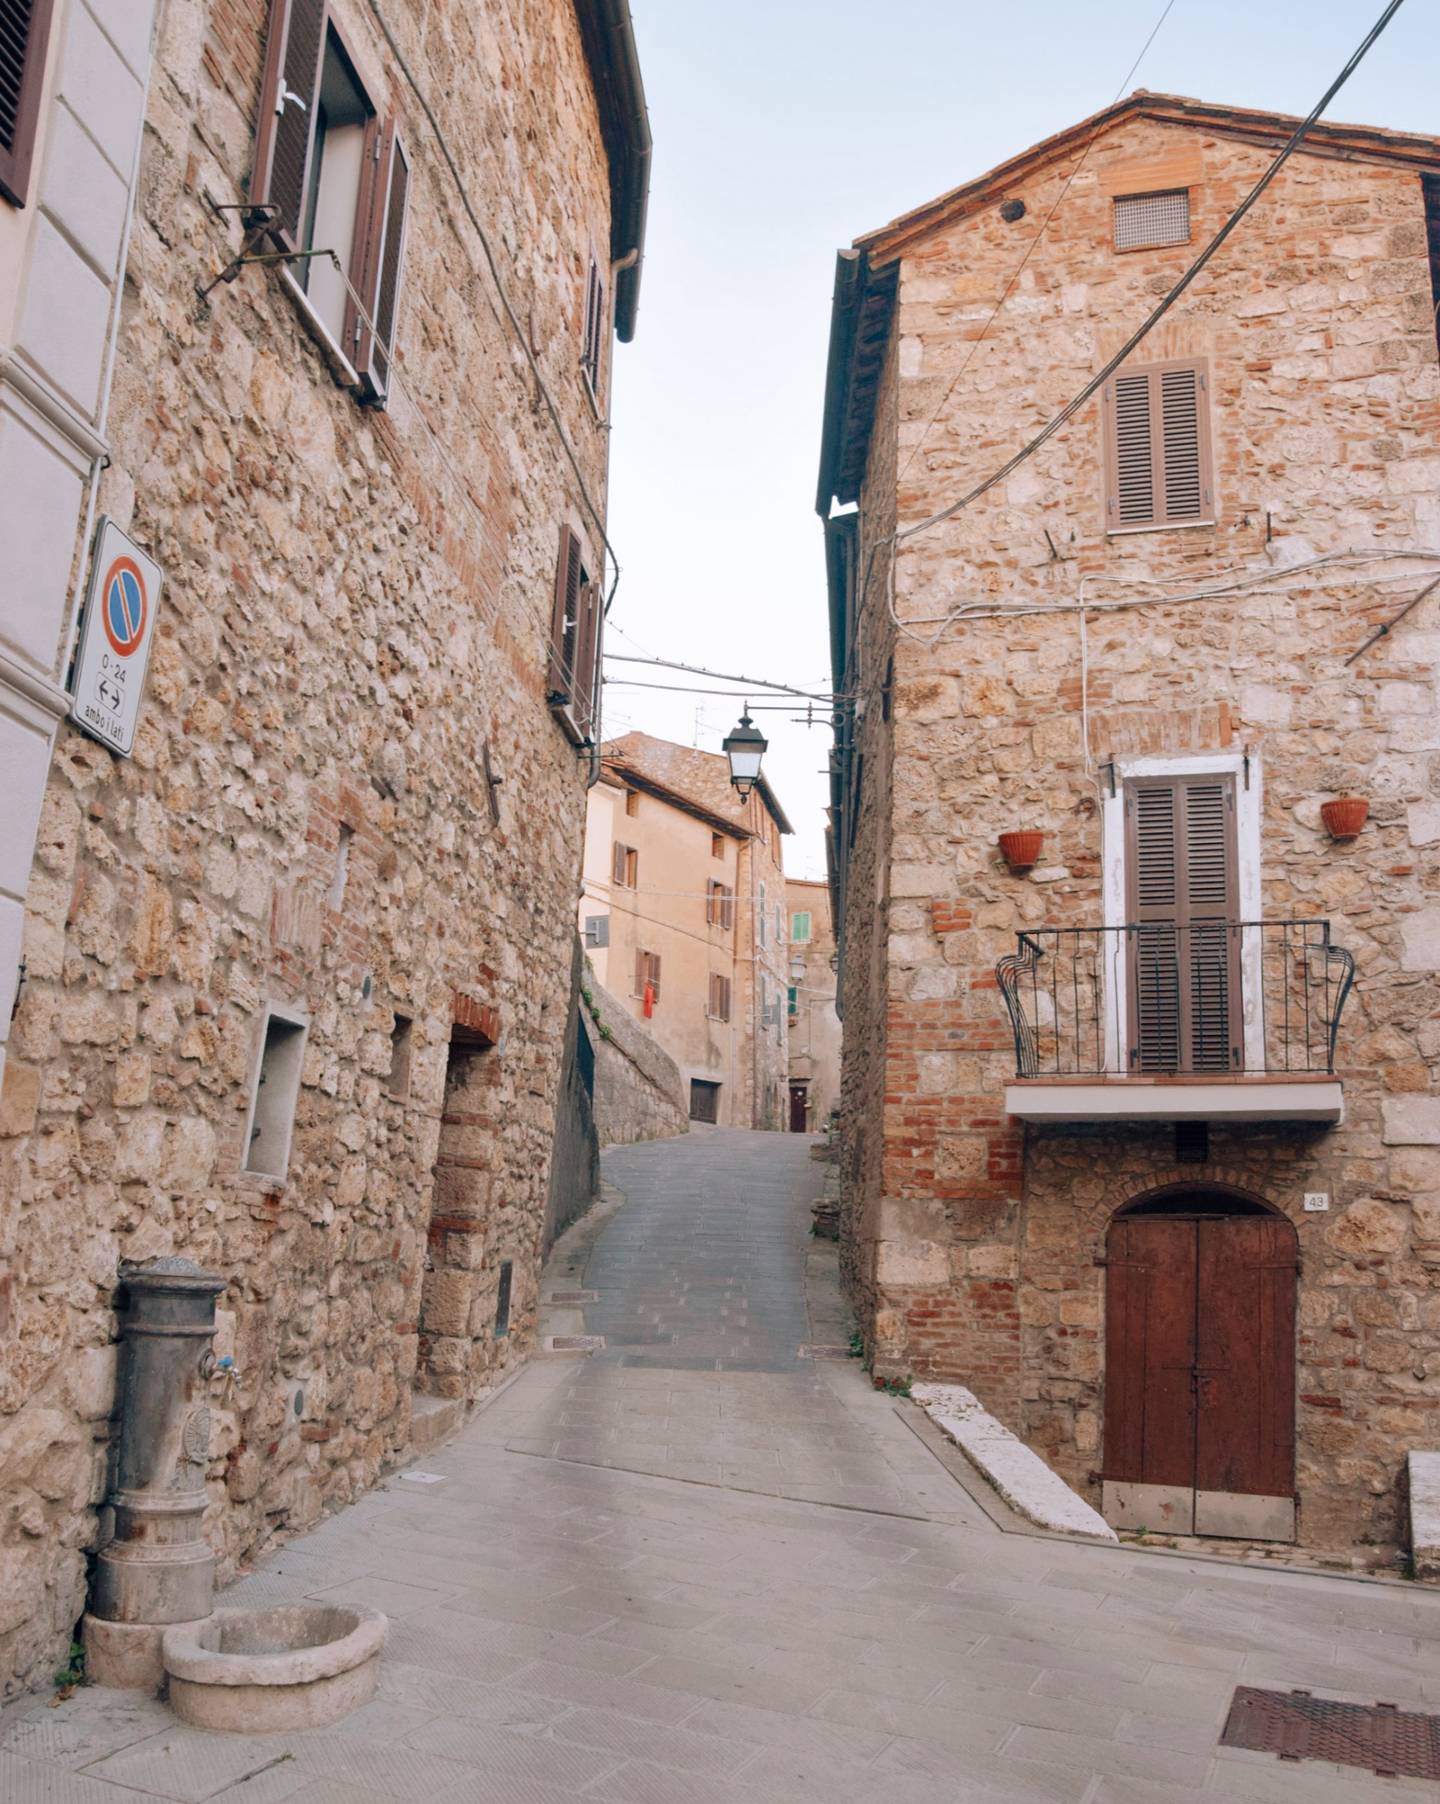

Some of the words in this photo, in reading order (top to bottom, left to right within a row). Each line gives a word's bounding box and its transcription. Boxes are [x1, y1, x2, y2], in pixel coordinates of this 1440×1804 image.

[85, 705, 104, 728] ambo
[111, 718, 124, 743] lati
[1309, 1197, 1324, 1207] 43
